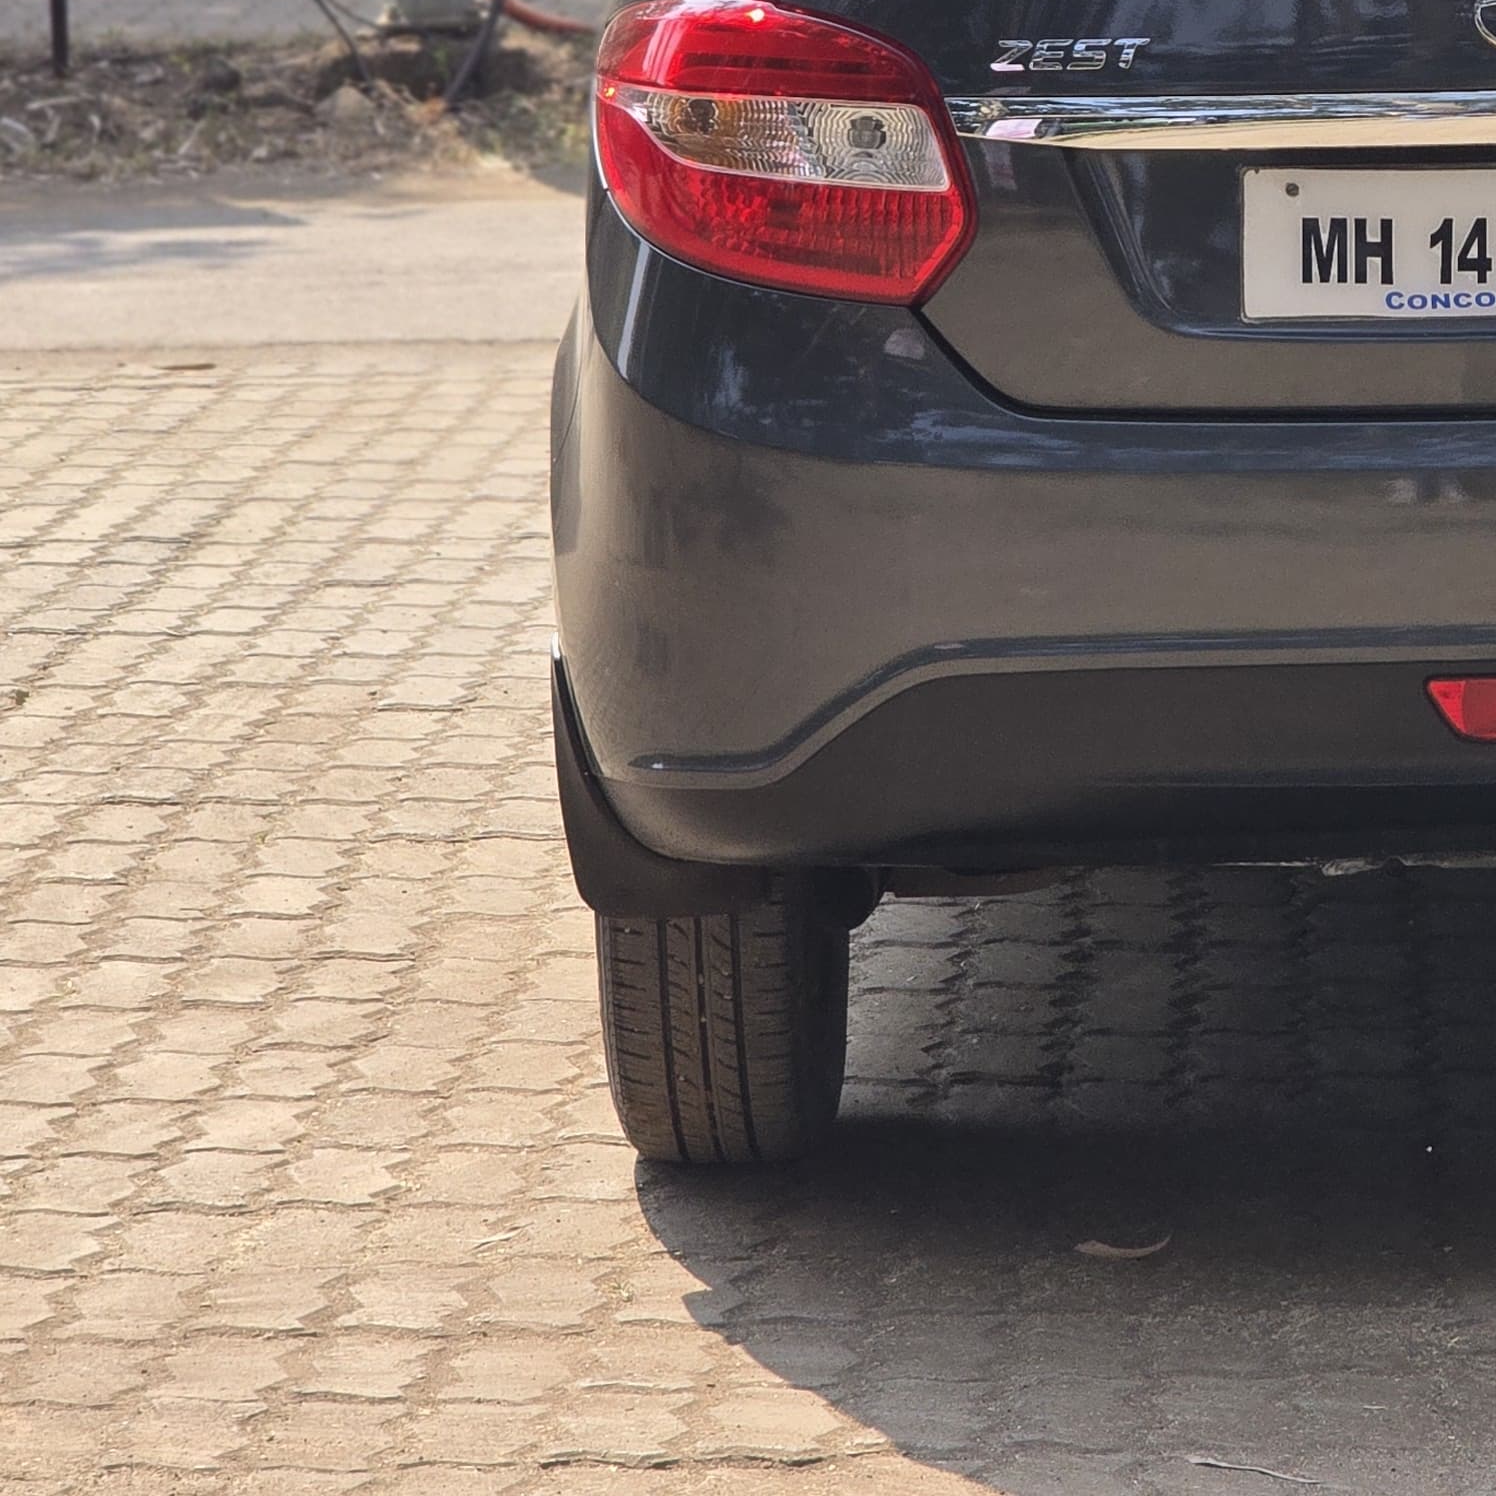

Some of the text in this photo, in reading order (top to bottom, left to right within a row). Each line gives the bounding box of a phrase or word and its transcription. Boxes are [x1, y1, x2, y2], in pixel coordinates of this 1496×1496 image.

[989, 37, 1151, 72] ZEST
[1301, 217, 1394, 285] MH
[1429, 217, 1493, 285] 14
